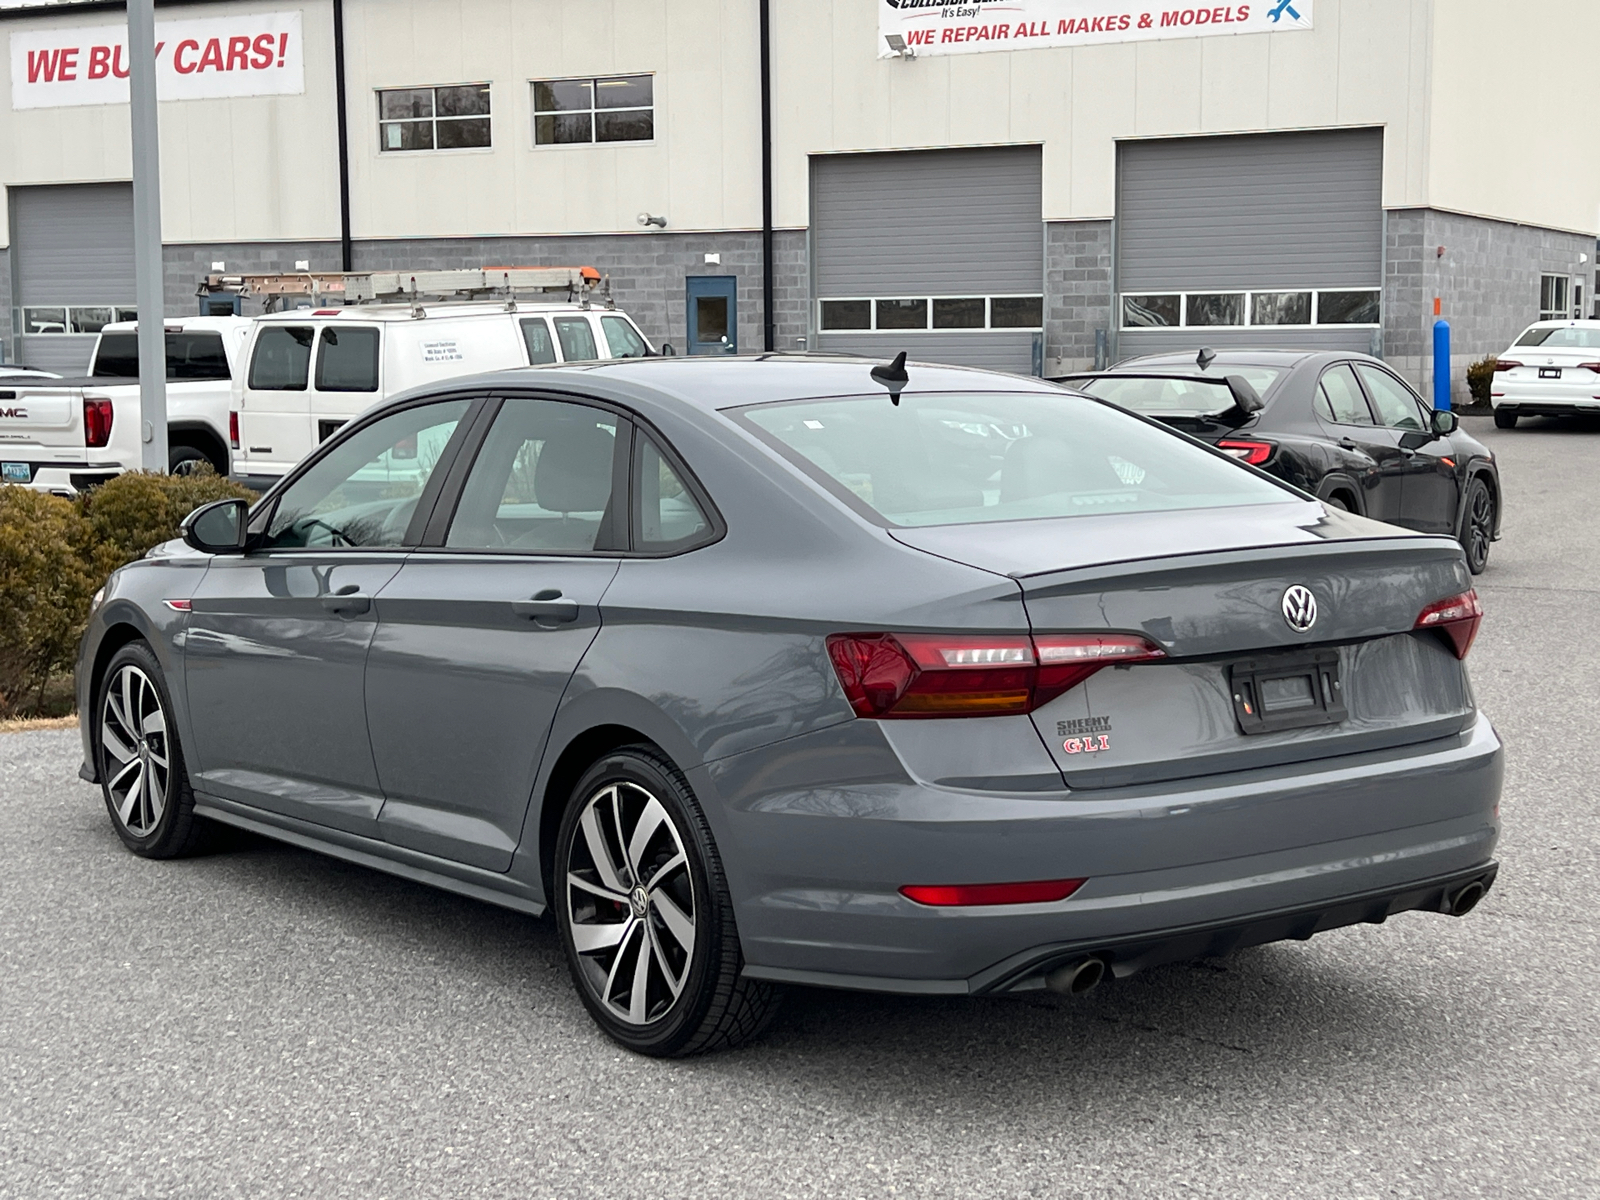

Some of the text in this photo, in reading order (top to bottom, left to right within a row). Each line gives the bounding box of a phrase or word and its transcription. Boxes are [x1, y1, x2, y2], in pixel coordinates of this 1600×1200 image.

[941, 5, 980, 18] It's Easy!
[907, 5, 1250, 46] WE REPAIR ALL MAKES & MODELS
[27, 48, 79, 83] WE
[174, 33, 289, 74] CARS!
[0, 408, 28, 418] MC
[1056, 716, 1110, 730] SHEEHY
[1063, 735, 1110, 754] GLI
